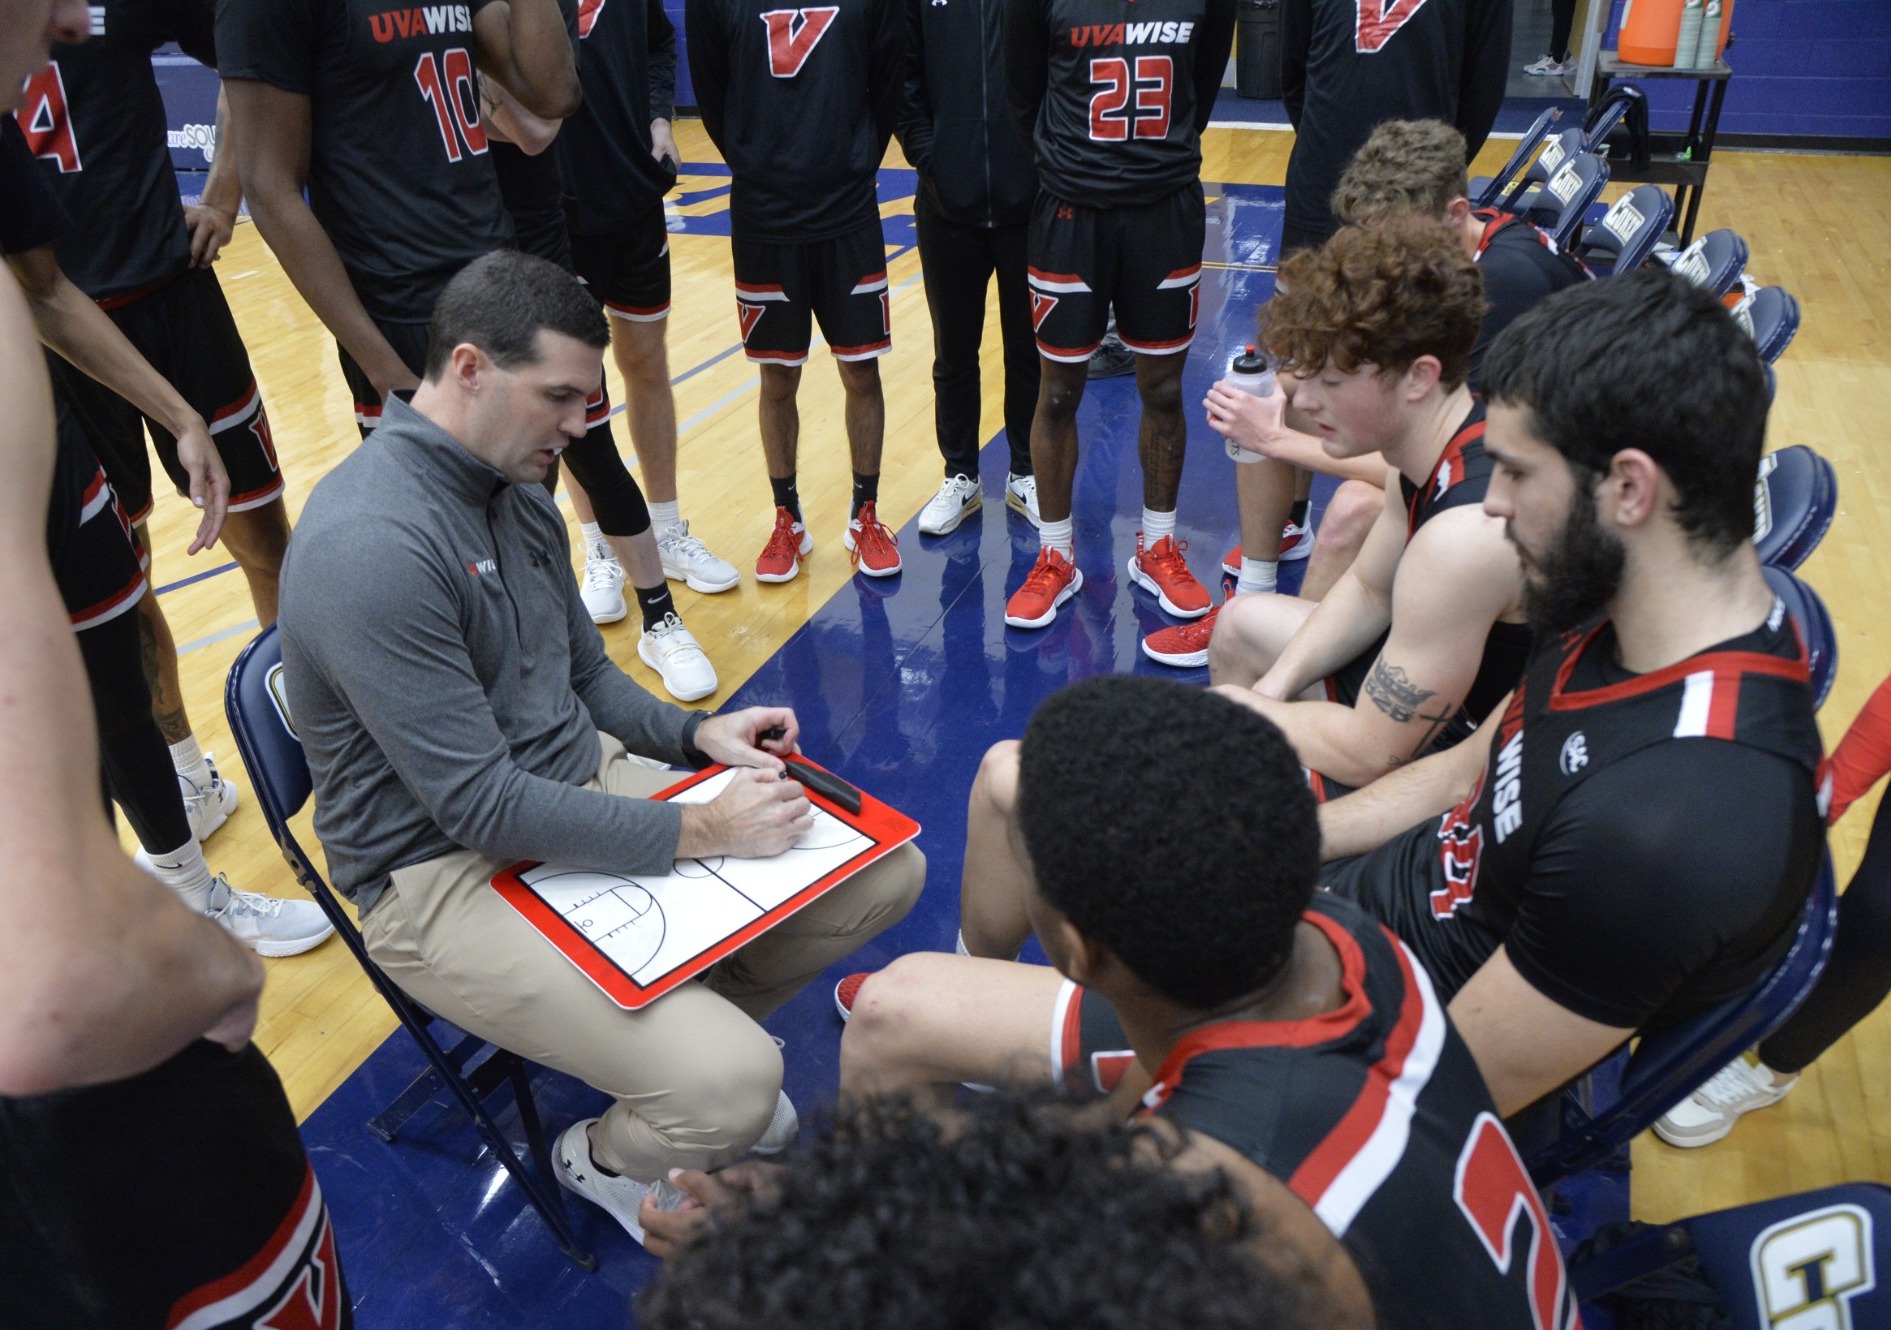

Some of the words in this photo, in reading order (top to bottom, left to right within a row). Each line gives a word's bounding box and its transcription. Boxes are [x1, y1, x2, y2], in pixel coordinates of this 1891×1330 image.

[760, 8, 840, 79] V
[1070, 21, 1195, 48] UVAWISE
[413, 48, 489, 163] 10
[1089, 55, 1173, 141] 23
